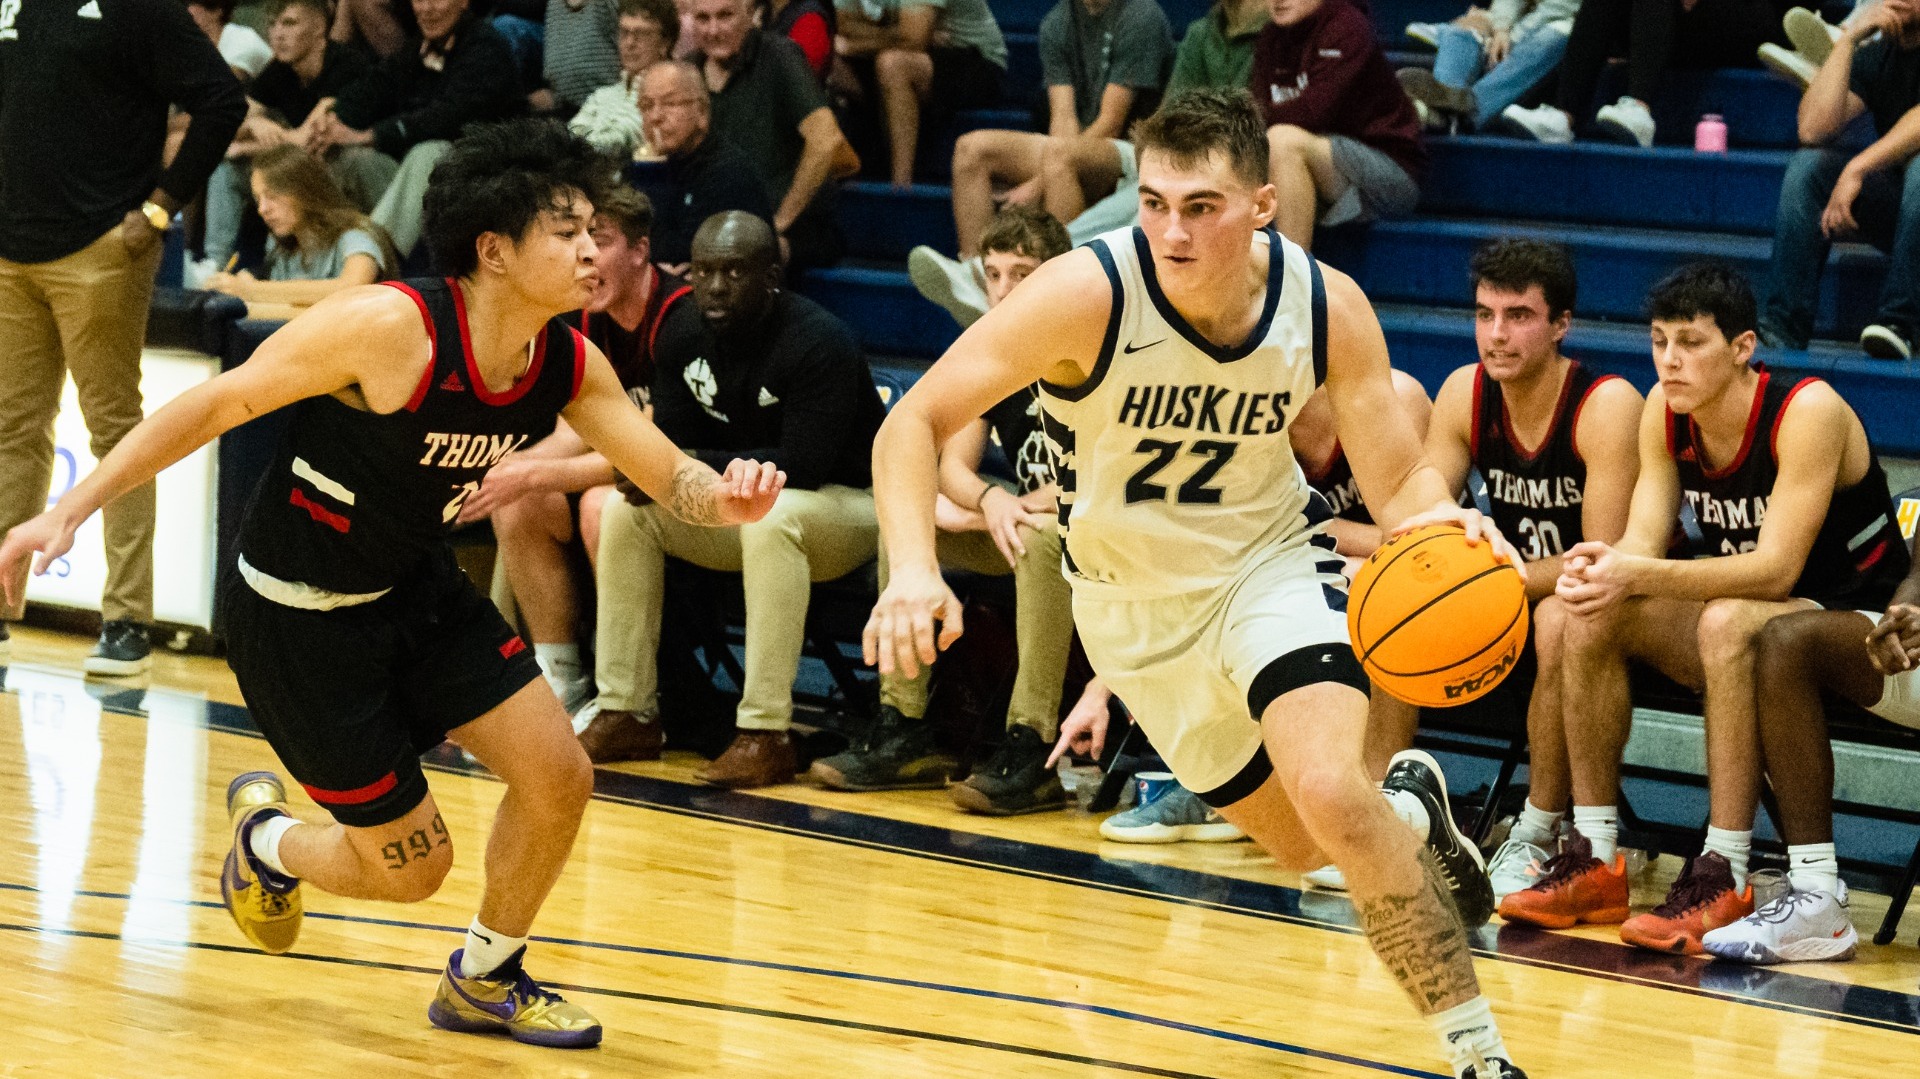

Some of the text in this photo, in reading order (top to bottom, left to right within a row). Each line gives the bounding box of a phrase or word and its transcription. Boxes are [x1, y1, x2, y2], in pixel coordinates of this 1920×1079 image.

[1117, 384, 1292, 436] HUSKIES
[419, 432, 528, 469] THOM
[1123, 436, 1241, 507] 22
[1489, 468, 1583, 509] THOMAS
[1518, 517, 1565, 561] 30
[1443, 643, 1517, 699] NCAA
